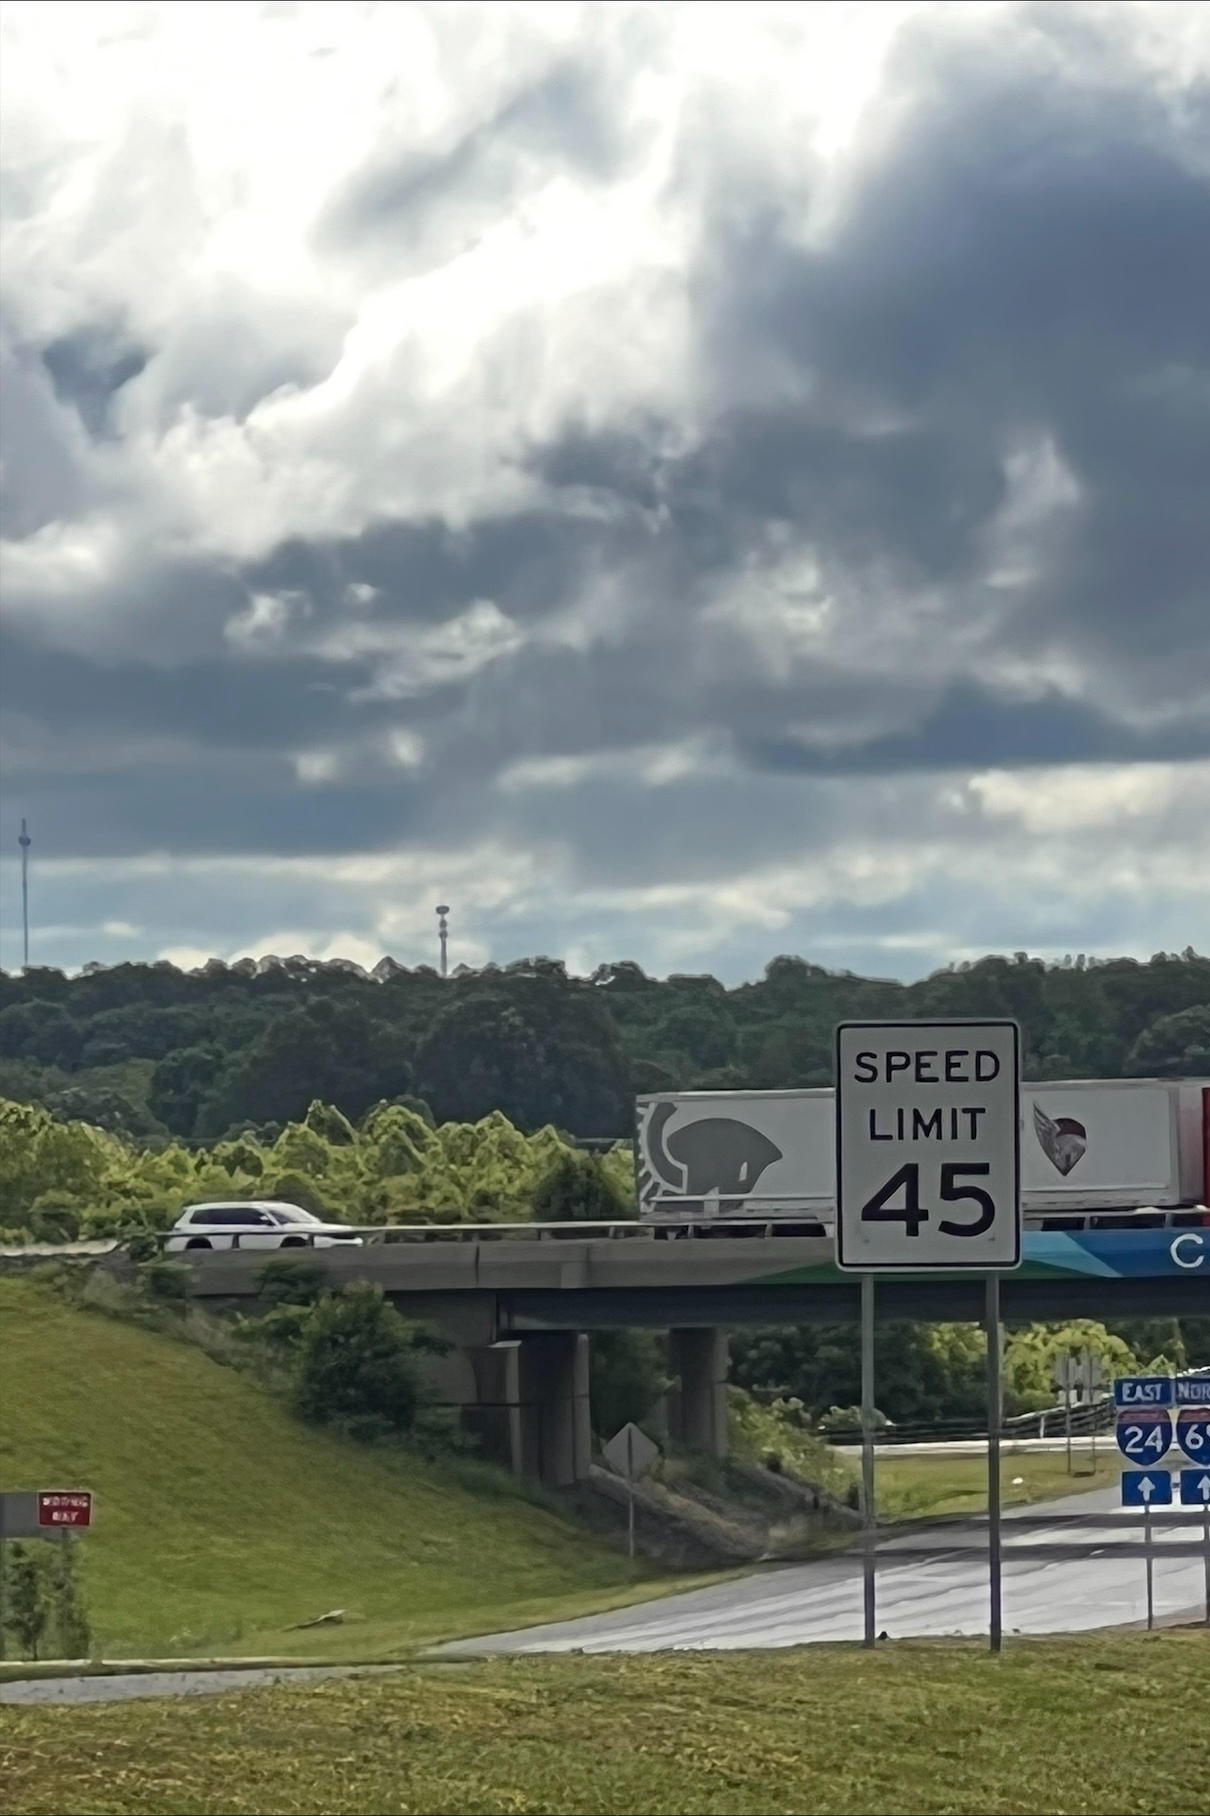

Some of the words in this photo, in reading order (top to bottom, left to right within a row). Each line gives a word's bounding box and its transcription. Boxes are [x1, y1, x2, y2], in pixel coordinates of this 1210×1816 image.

[854, 1050, 1000, 1083] SPEED
[869, 1107, 986, 1141] LIMIT
[861, 1162, 996, 1237] 45
[1122, 1382, 1165, 1401] EAST
[1124, 1425, 1163, 1453] 24
